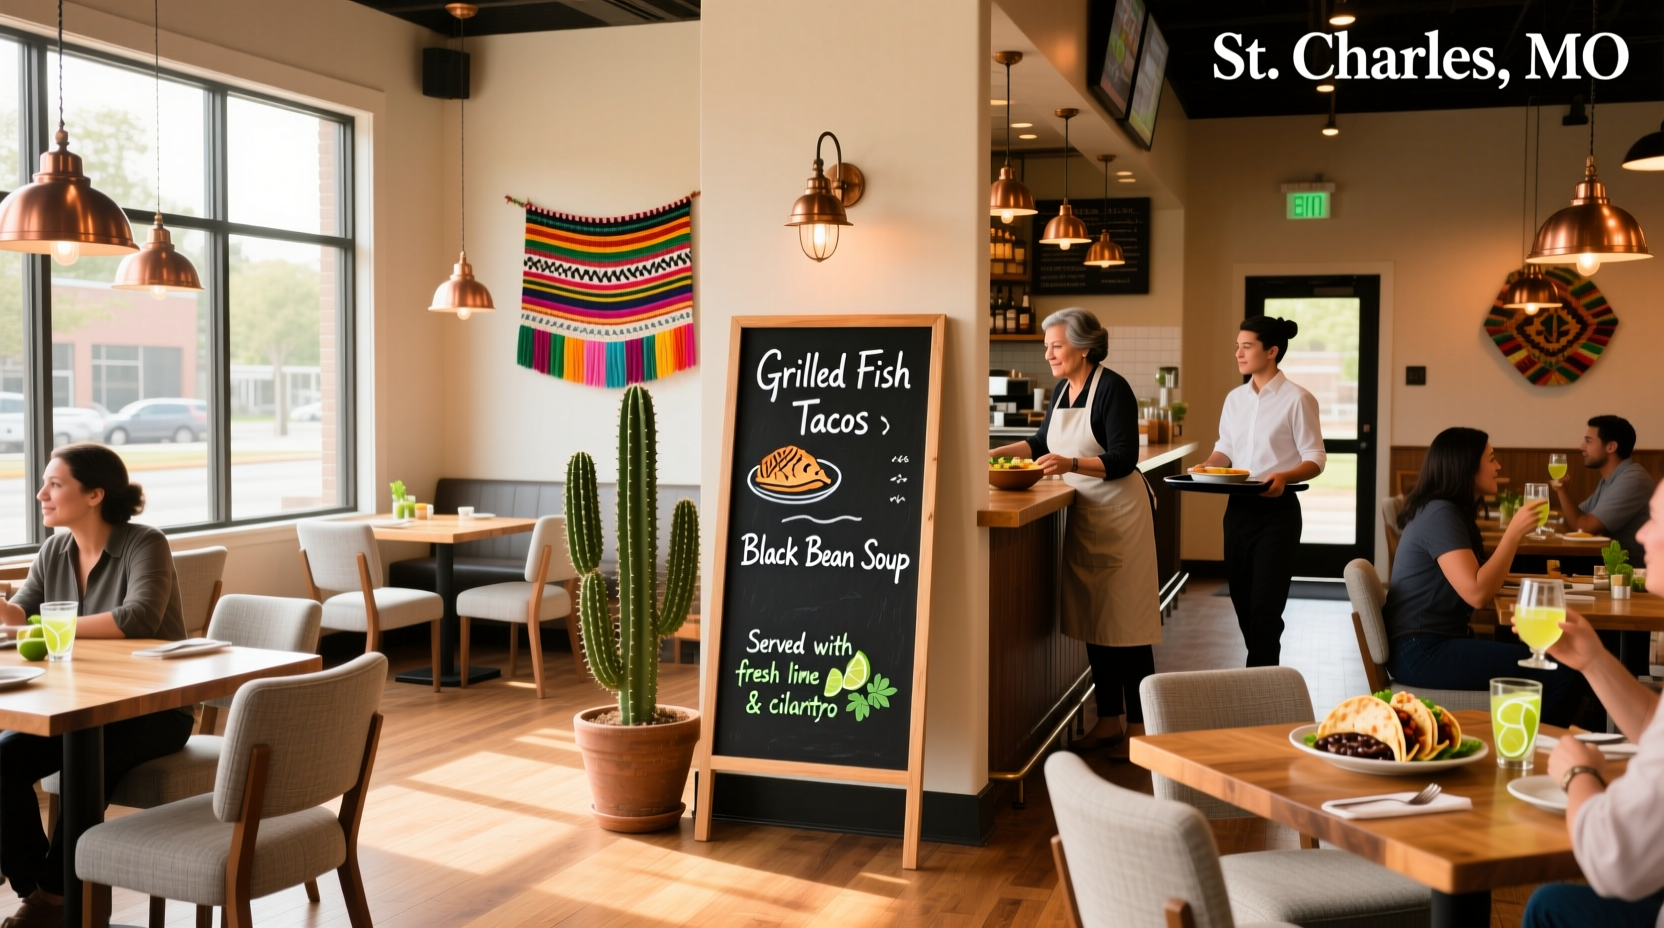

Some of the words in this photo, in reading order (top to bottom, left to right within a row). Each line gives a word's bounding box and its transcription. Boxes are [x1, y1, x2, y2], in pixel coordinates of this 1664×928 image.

[756, 348, 847, 403] Grilled
[856, 348, 911, 390] Fish
[792, 398, 869, 436] Tacos
[740, 532, 799, 566] Black
[805, 534, 854, 568] Bean
[860, 538, 911, 585] Soup
[746, 628, 807, 655] Served
[813, 632, 853, 656] with
[735, 658, 780, 688] fresh
[787, 661, 820, 685] lime
[745, 690, 762, 715] &
[769, 691, 838, 723] cilantro
